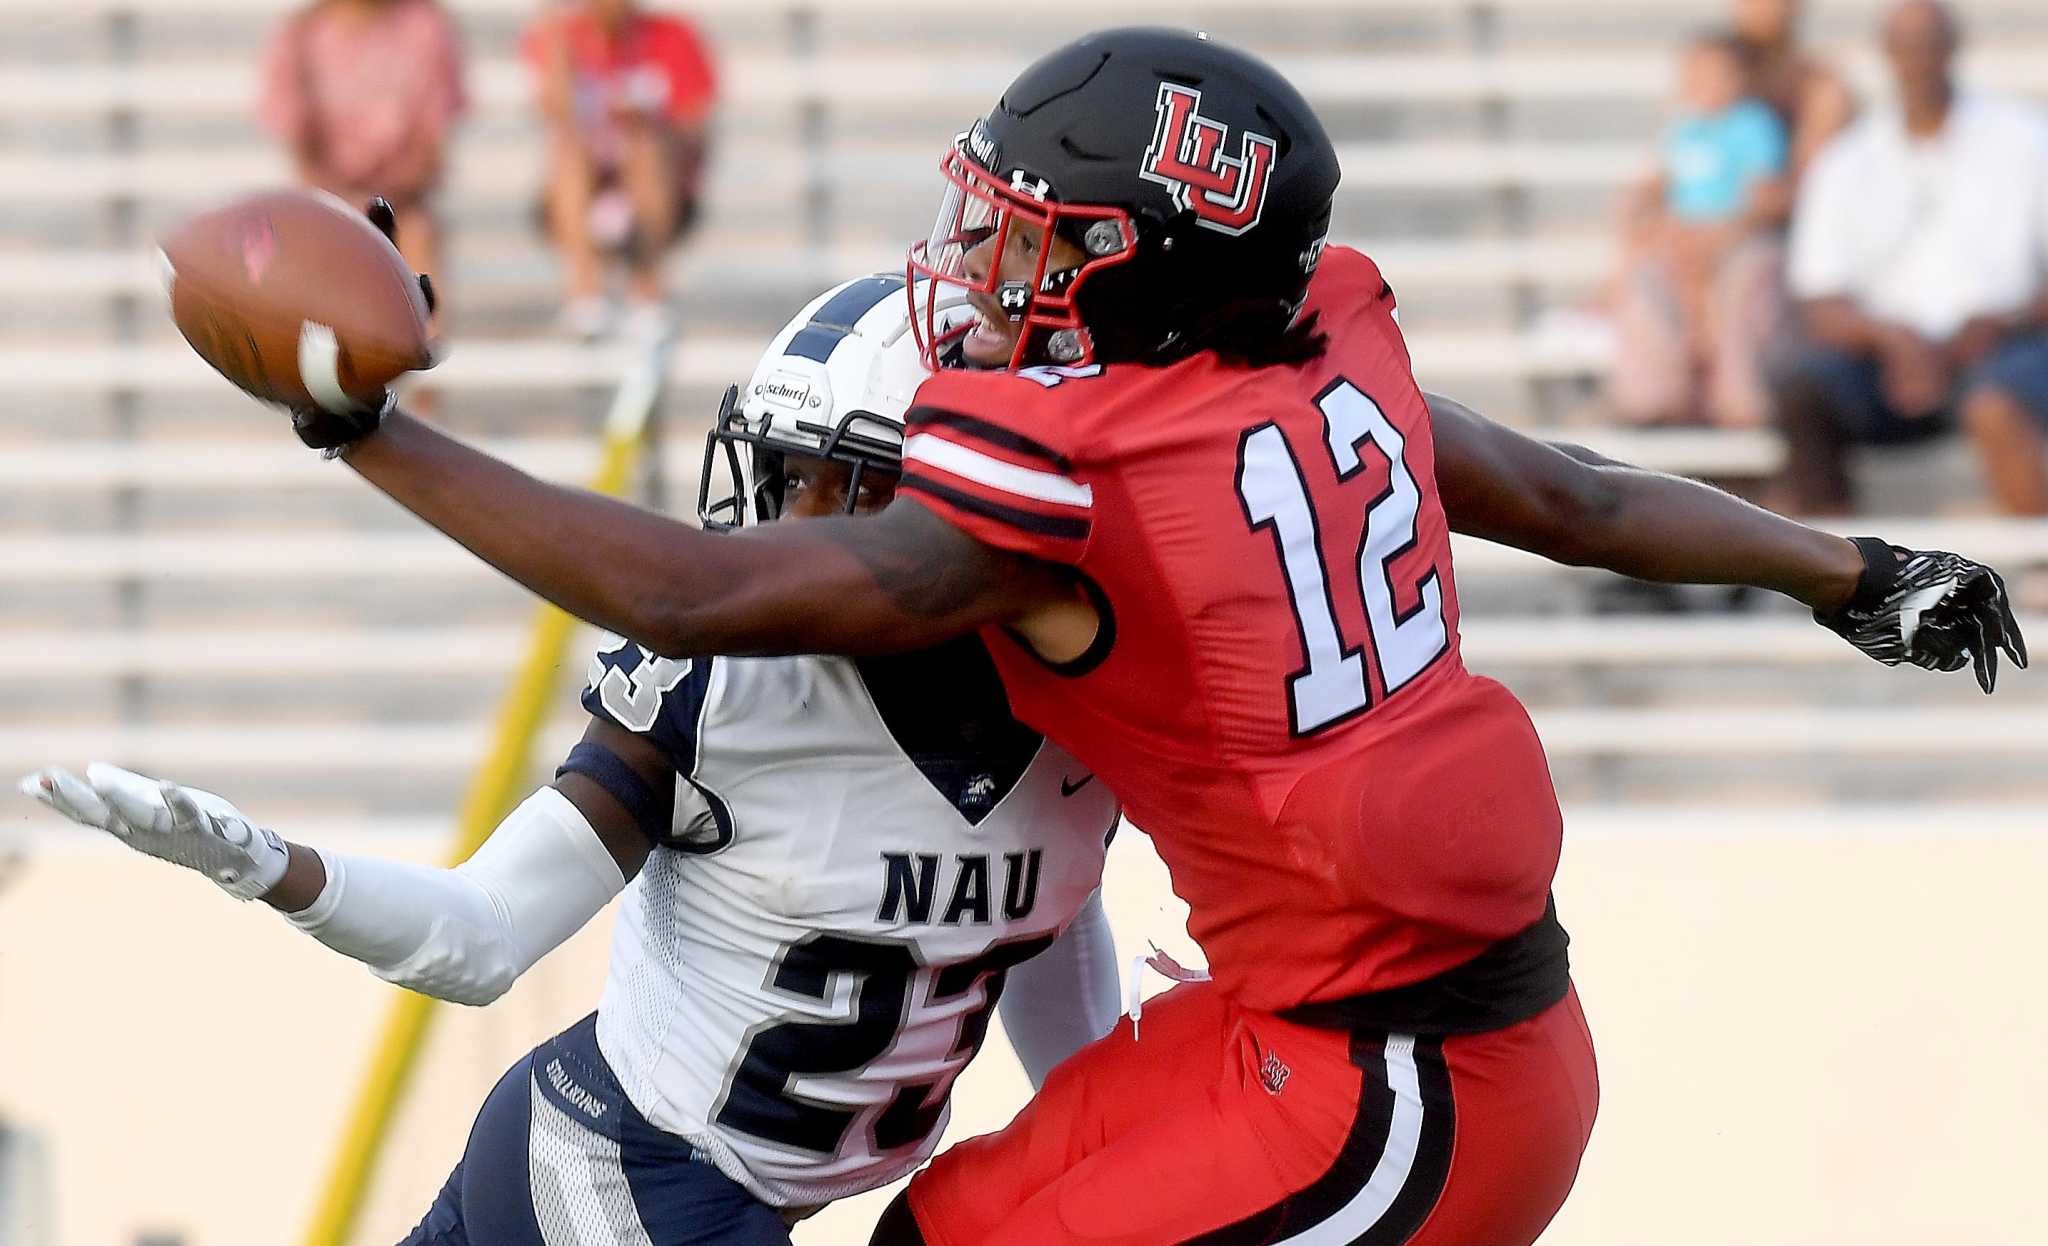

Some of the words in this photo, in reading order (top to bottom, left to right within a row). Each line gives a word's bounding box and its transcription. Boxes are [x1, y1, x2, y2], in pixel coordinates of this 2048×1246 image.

[1139, 81, 1277, 237] LU
[1234, 375, 1450, 739] 12
[874, 849, 1044, 927] NAU
[707, 929, 1062, 1160] 23
